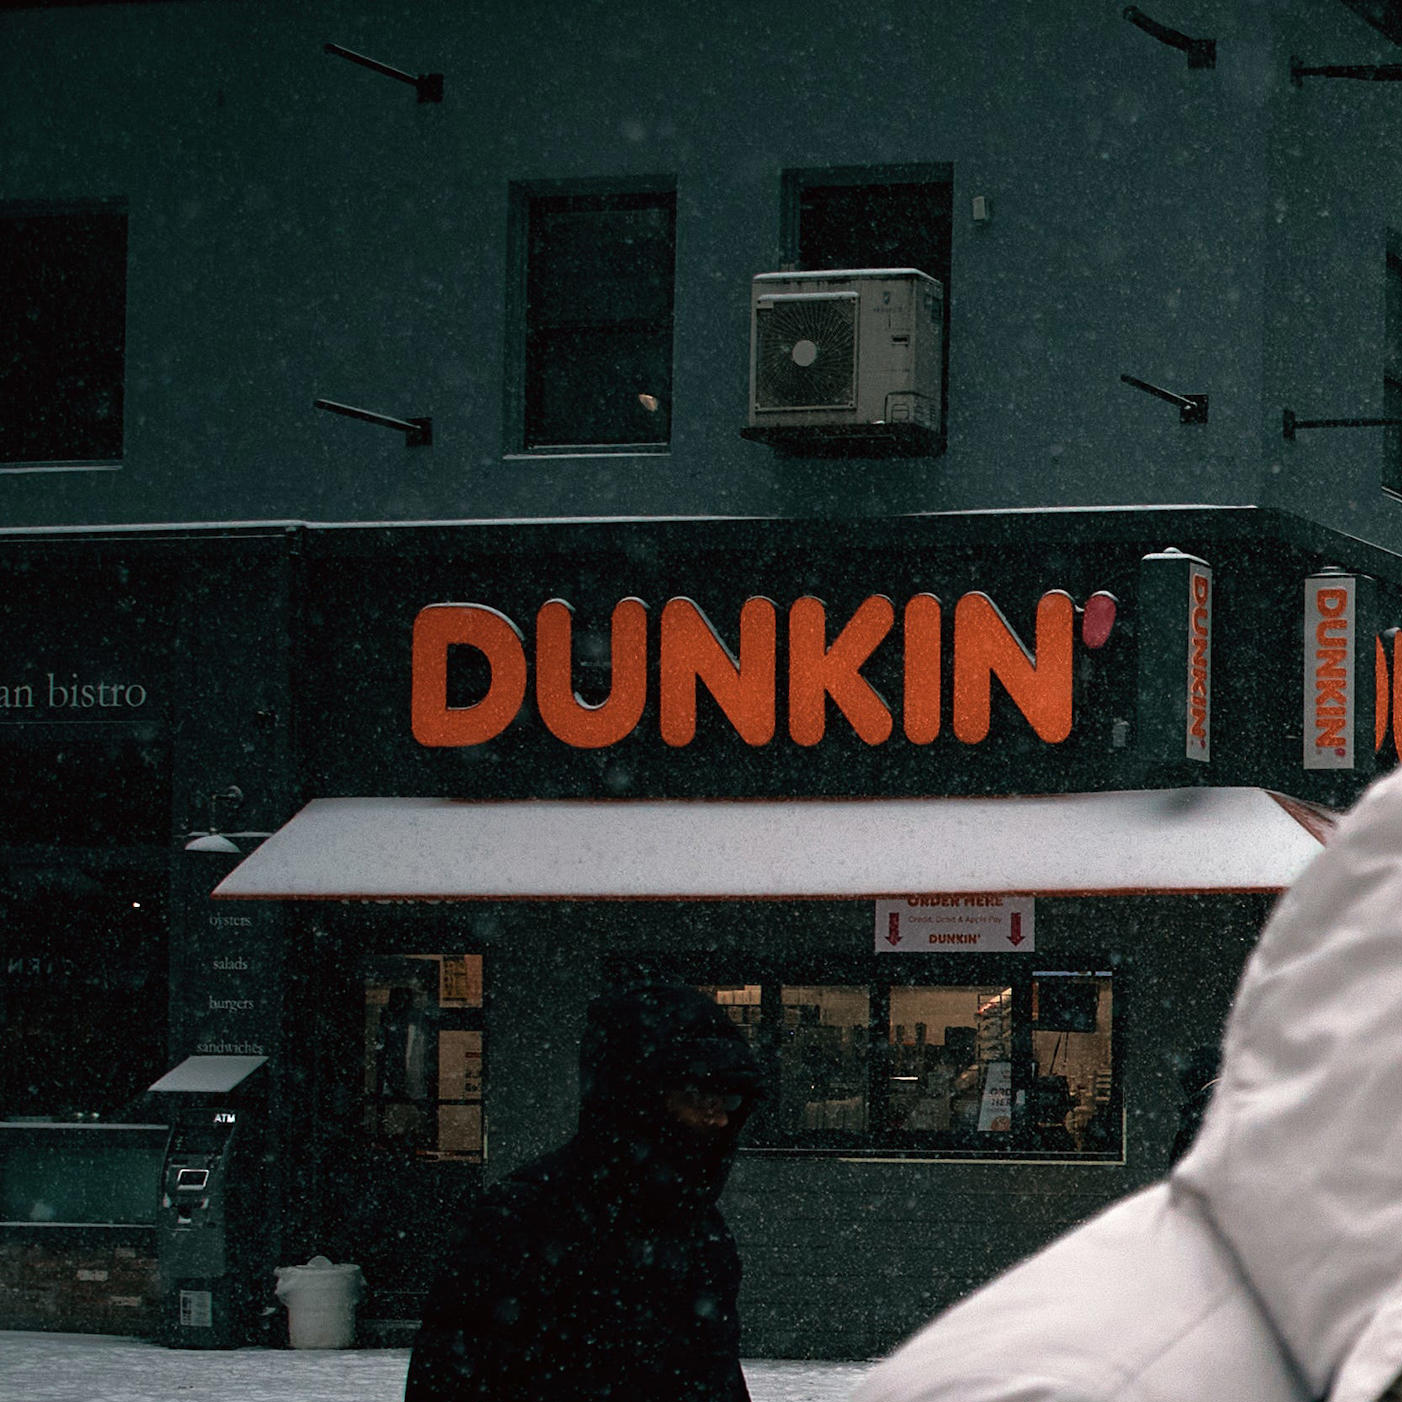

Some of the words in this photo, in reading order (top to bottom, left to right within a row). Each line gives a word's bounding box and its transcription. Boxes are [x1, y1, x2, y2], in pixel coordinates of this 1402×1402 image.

[1190, 573, 1209, 749] DUNKIN'
[411, 591, 1116, 750] DUNKIN'
[1315, 588, 1348, 757] DUNKIN'
[47, 672, 148, 708] bistro
[209, 914, 252, 930] oysters
[928, 933, 981, 945] DUNKIN'
[212, 957, 249, 971] salads
[208, 996, 255, 1012] burgers
[196, 1040, 265, 1055] sandwiches
[214, 1113, 236, 1124] ATM
